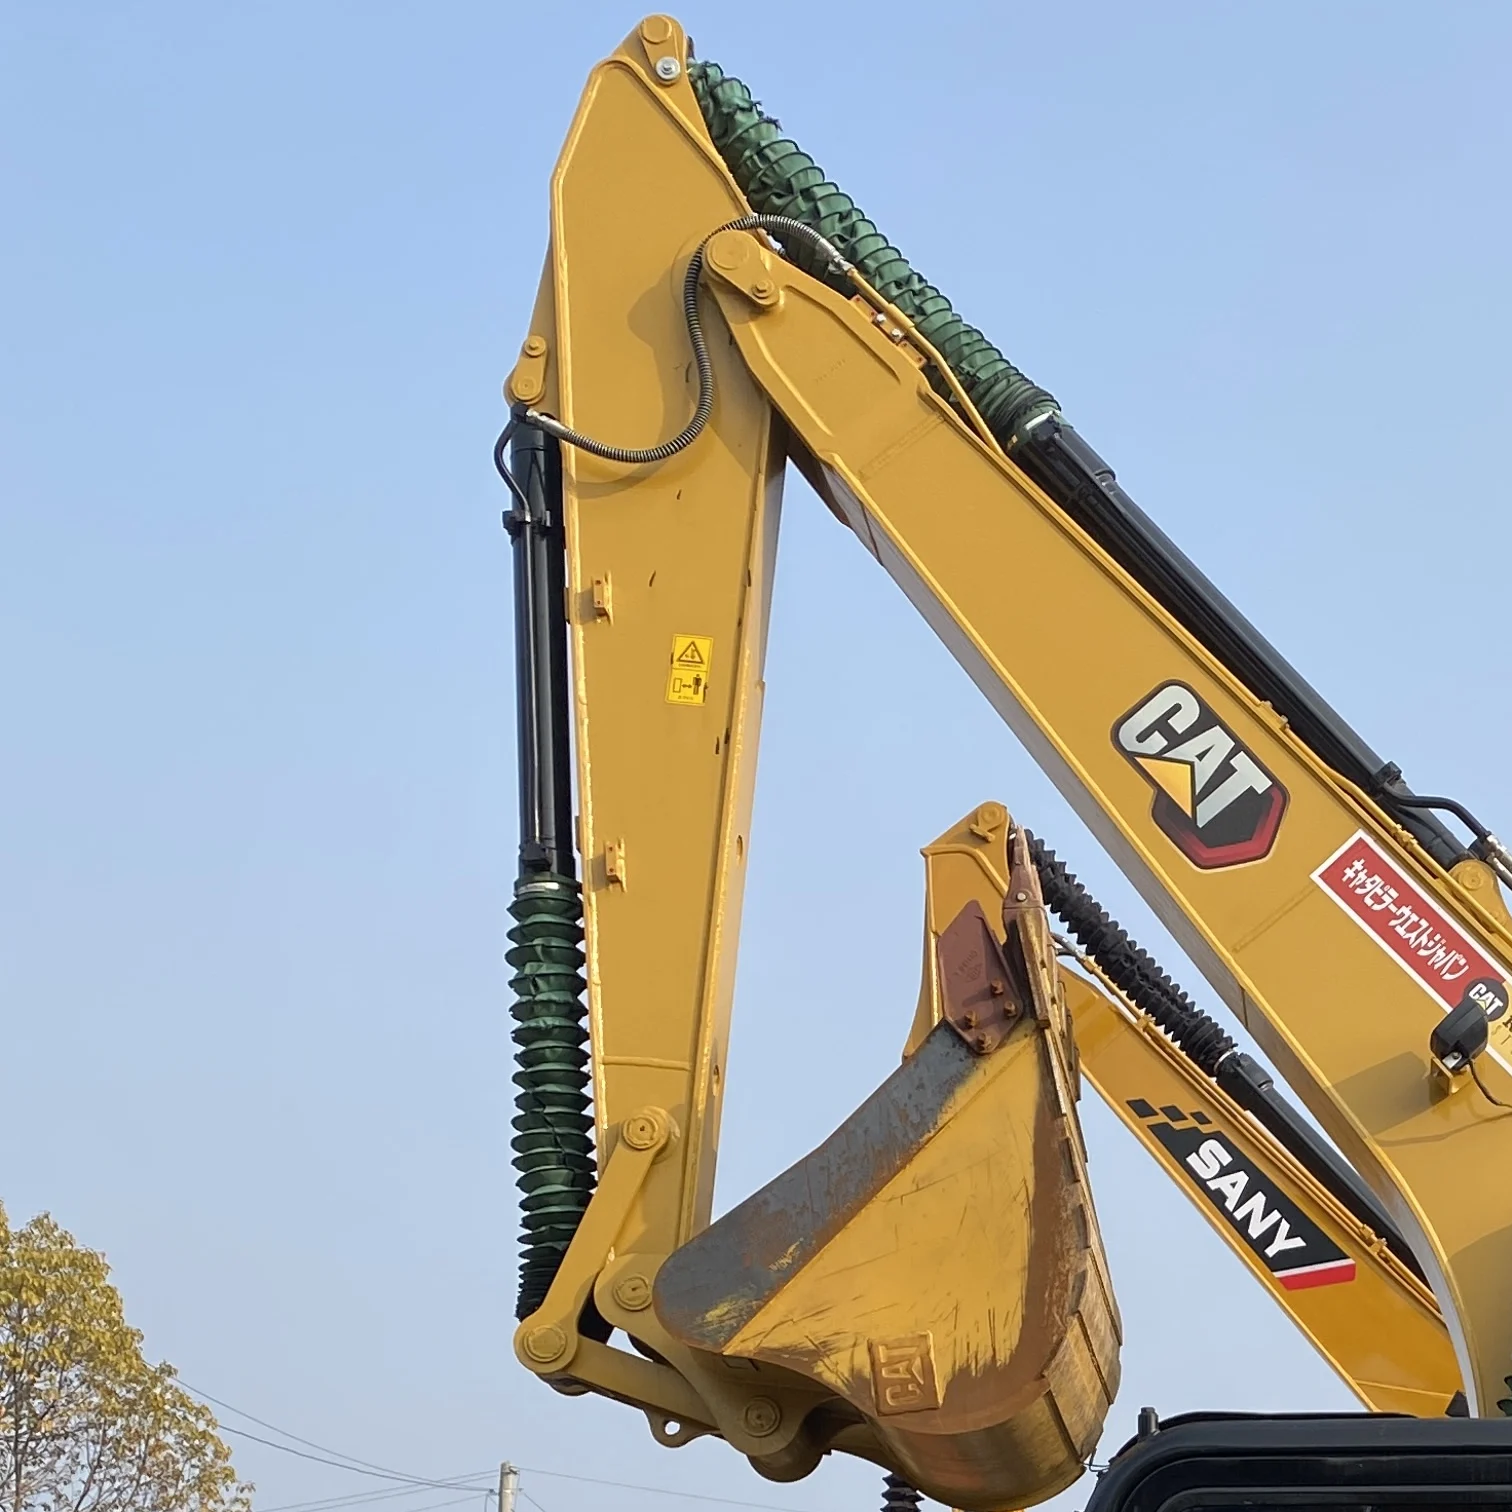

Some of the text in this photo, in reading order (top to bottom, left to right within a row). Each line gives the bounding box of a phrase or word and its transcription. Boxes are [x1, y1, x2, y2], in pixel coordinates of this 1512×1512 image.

[1118, 685, 1272, 829] CAT
[1468, 983, 1503, 1015] CAT
[1185, 1139, 1307, 1259] SANY
[879, 1345, 923, 1406] CAT
